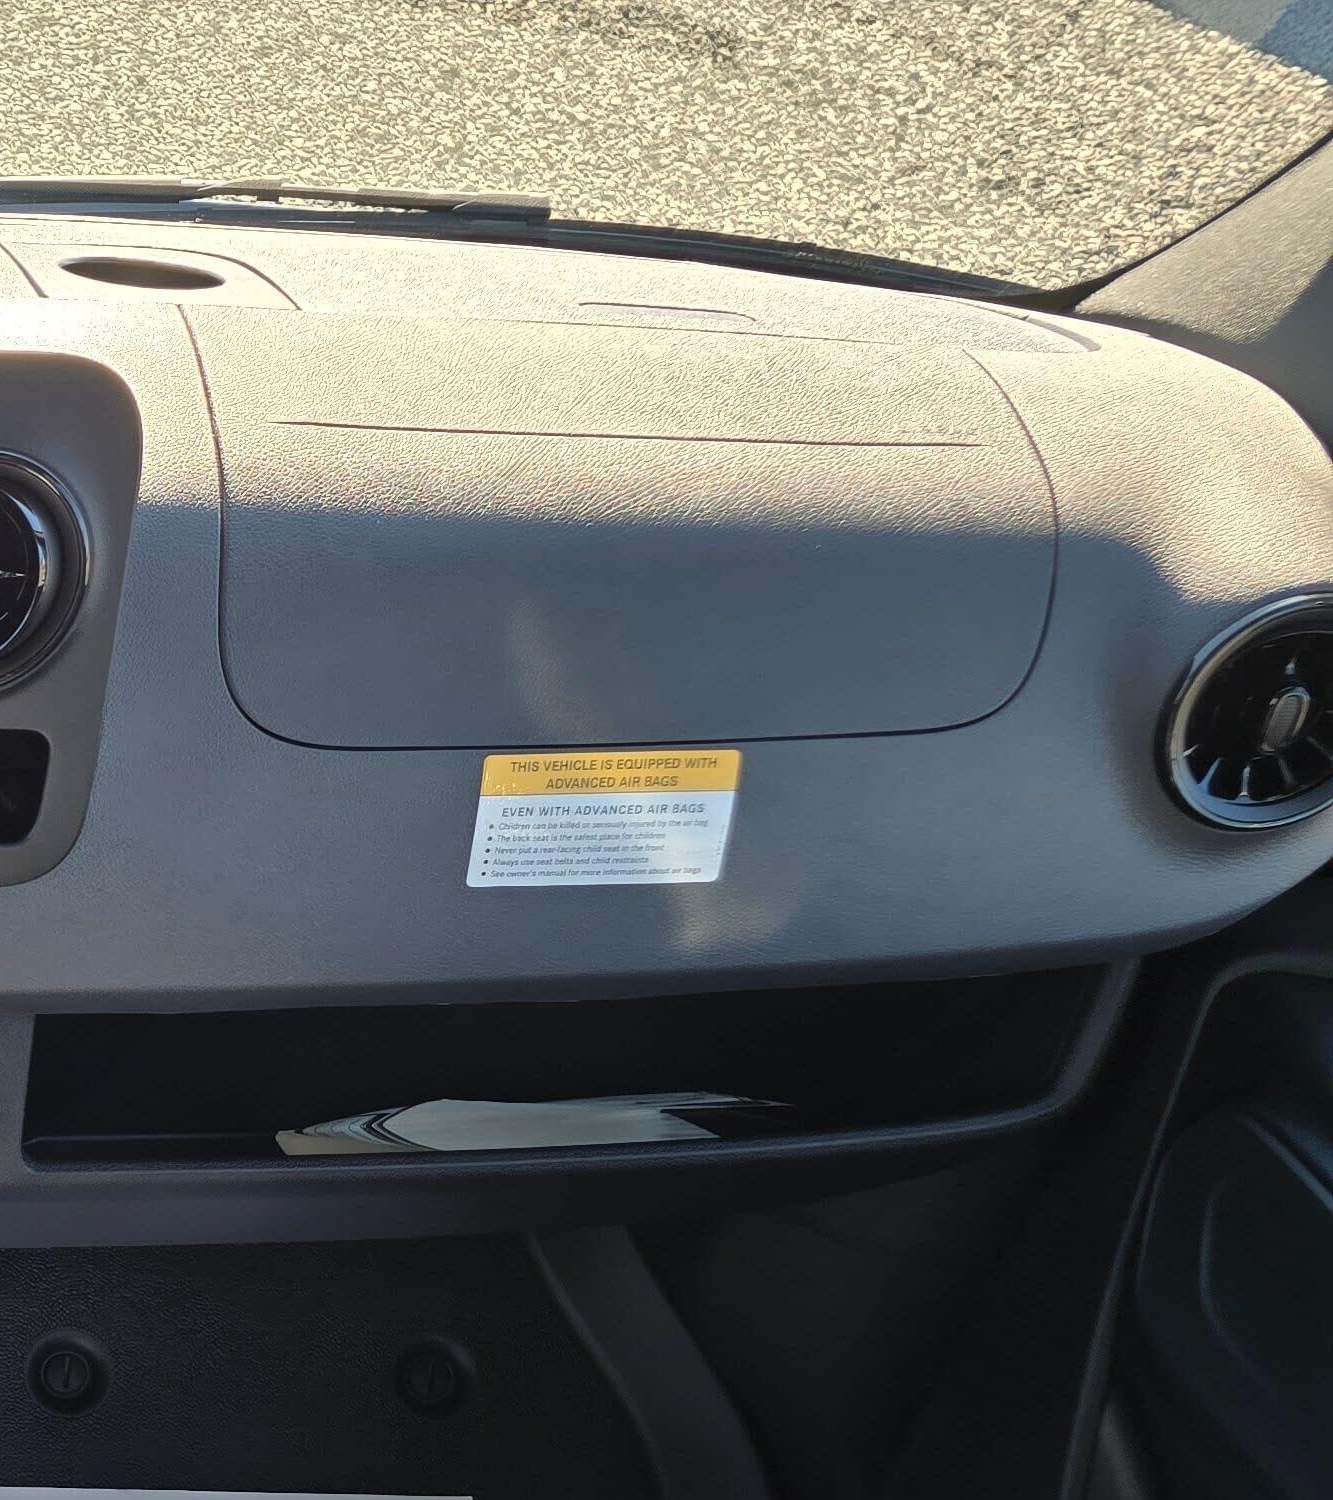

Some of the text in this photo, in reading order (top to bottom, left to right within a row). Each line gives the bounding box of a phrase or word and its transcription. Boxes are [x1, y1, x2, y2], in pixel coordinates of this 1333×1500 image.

[511, 757, 718, 773] THIS VEHICLE IS EQUIPPED WITH
[546, 775, 678, 790] ADVANCED AIR BAGS
[501, 803, 705, 817] EVEN WITH ADVANCED AIR BAGS
[498, 822, 530, 830] Children
[559, 821, 580, 829] killed
[622, 832, 633, 840] for
[518, 847, 532, 855] put
[493, 859, 518, 867] Always
